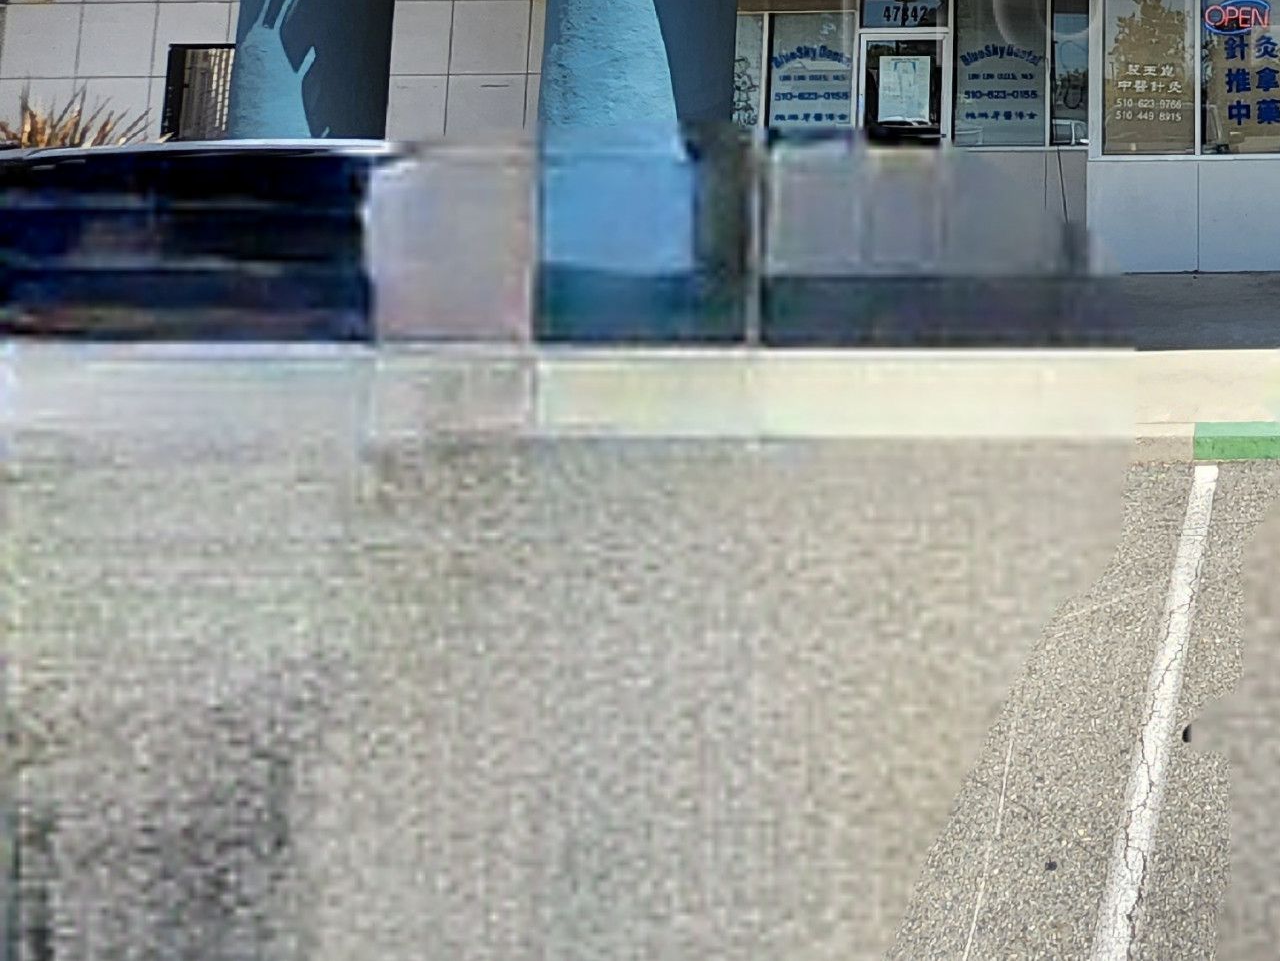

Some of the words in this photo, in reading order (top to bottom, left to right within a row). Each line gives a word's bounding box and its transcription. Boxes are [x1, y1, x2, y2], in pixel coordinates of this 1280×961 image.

[1205, 5, 1269, 29] OPEN
[1224, 35, 1278, 60] 針灸
[1225, 67, 1280, 93] 推拿
[1115, 98, 1133, 108] 510
[1228, 98, 1280, 125] 中藥
[1115, 111, 1133, 120] 510
